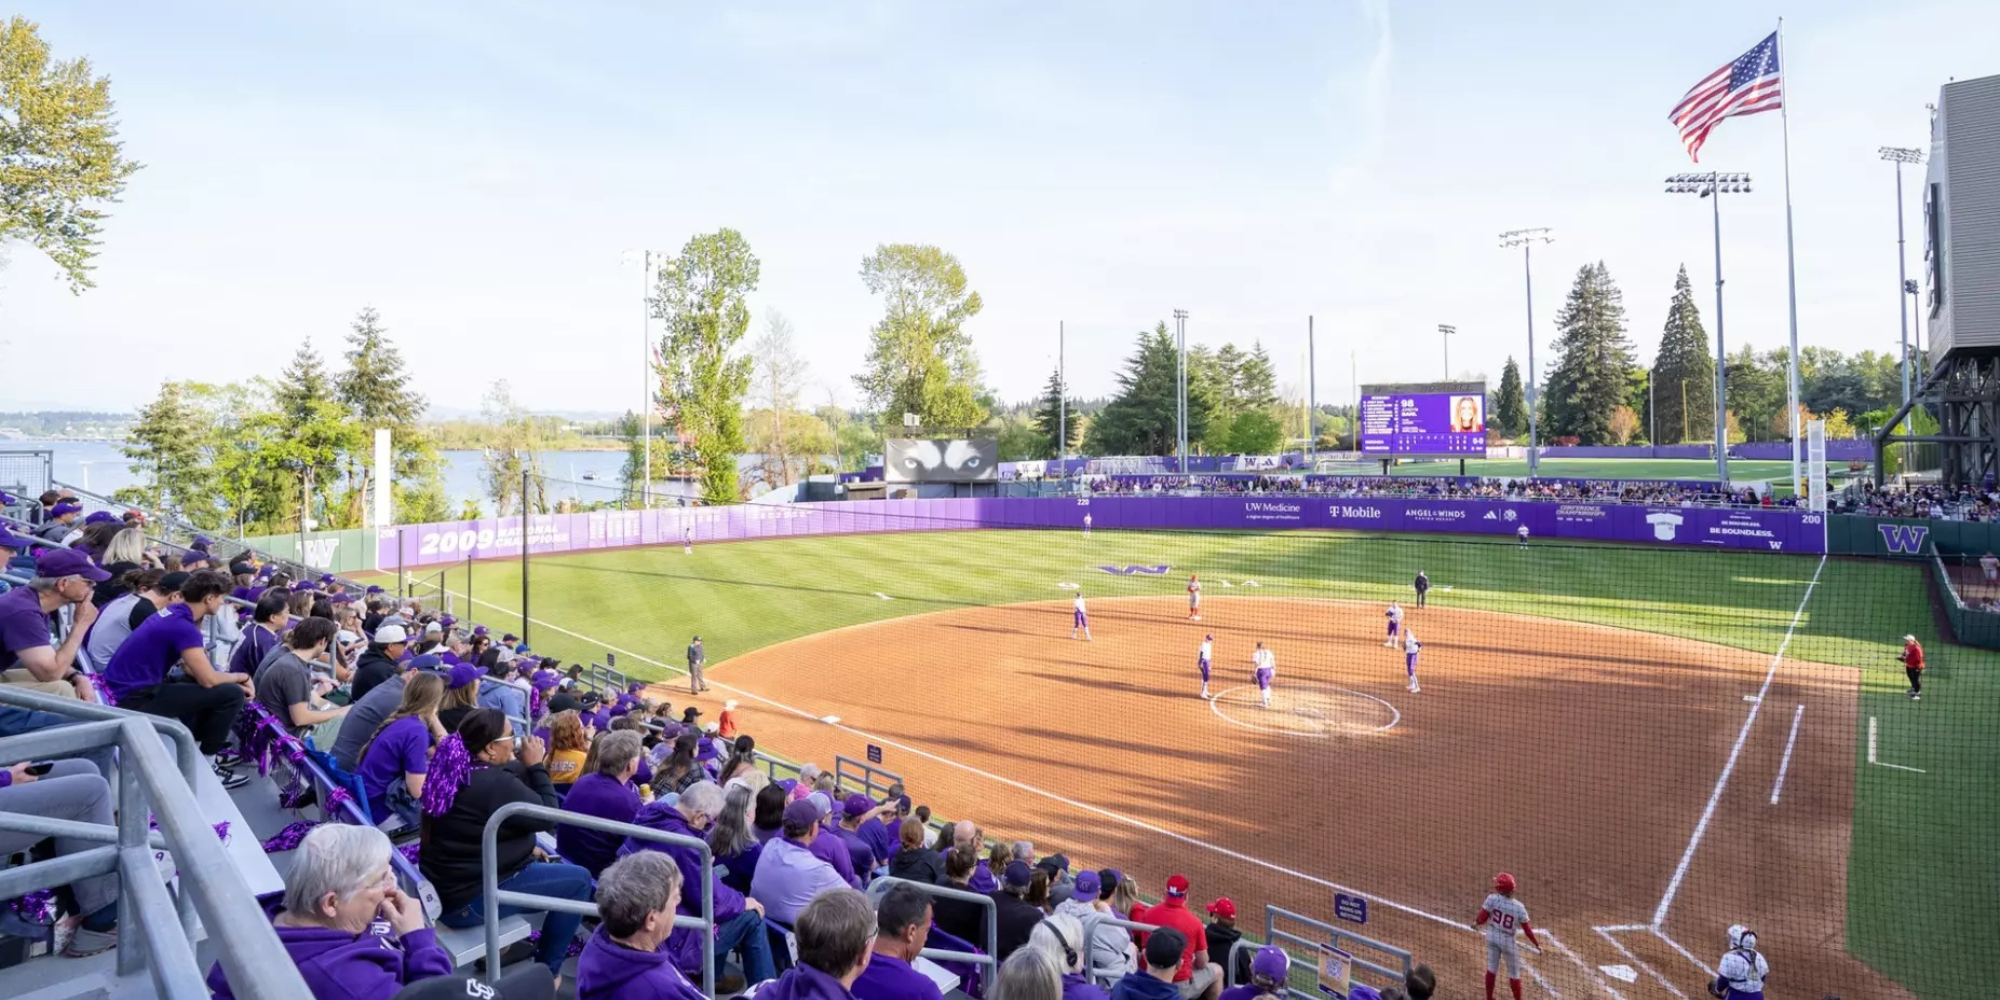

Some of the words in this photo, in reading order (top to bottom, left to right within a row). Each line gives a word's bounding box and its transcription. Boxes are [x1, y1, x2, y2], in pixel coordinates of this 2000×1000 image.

[1401, 399, 1414, 408] 98
[1245, 502, 1262, 512] UW
[1263, 502, 1301, 513] Medicine
[1329, 505, 1340, 518] T
[1341, 505, 1381, 518] Mobile
[1560, 504, 1601, 512] CONFERENCE
[1405, 509, 1432, 517] ANGEL
[1438, 510, 1466, 519] WINDS
[1801, 514, 1822, 525] 200
[379, 528, 397, 539] 200
[497, 524, 559, 538] NATONAL
[1721, 528, 1775, 538] BOUNDLESS.
[418, 528, 495, 555] 2009
[1877, 523, 1929, 554] W
[1768, 540, 1783, 550] W
[295, 538, 339, 569] W
[155, 851, 165, 862] 9
[426, 893, 434, 903] 8
[1492, 908, 1515, 930] 98
